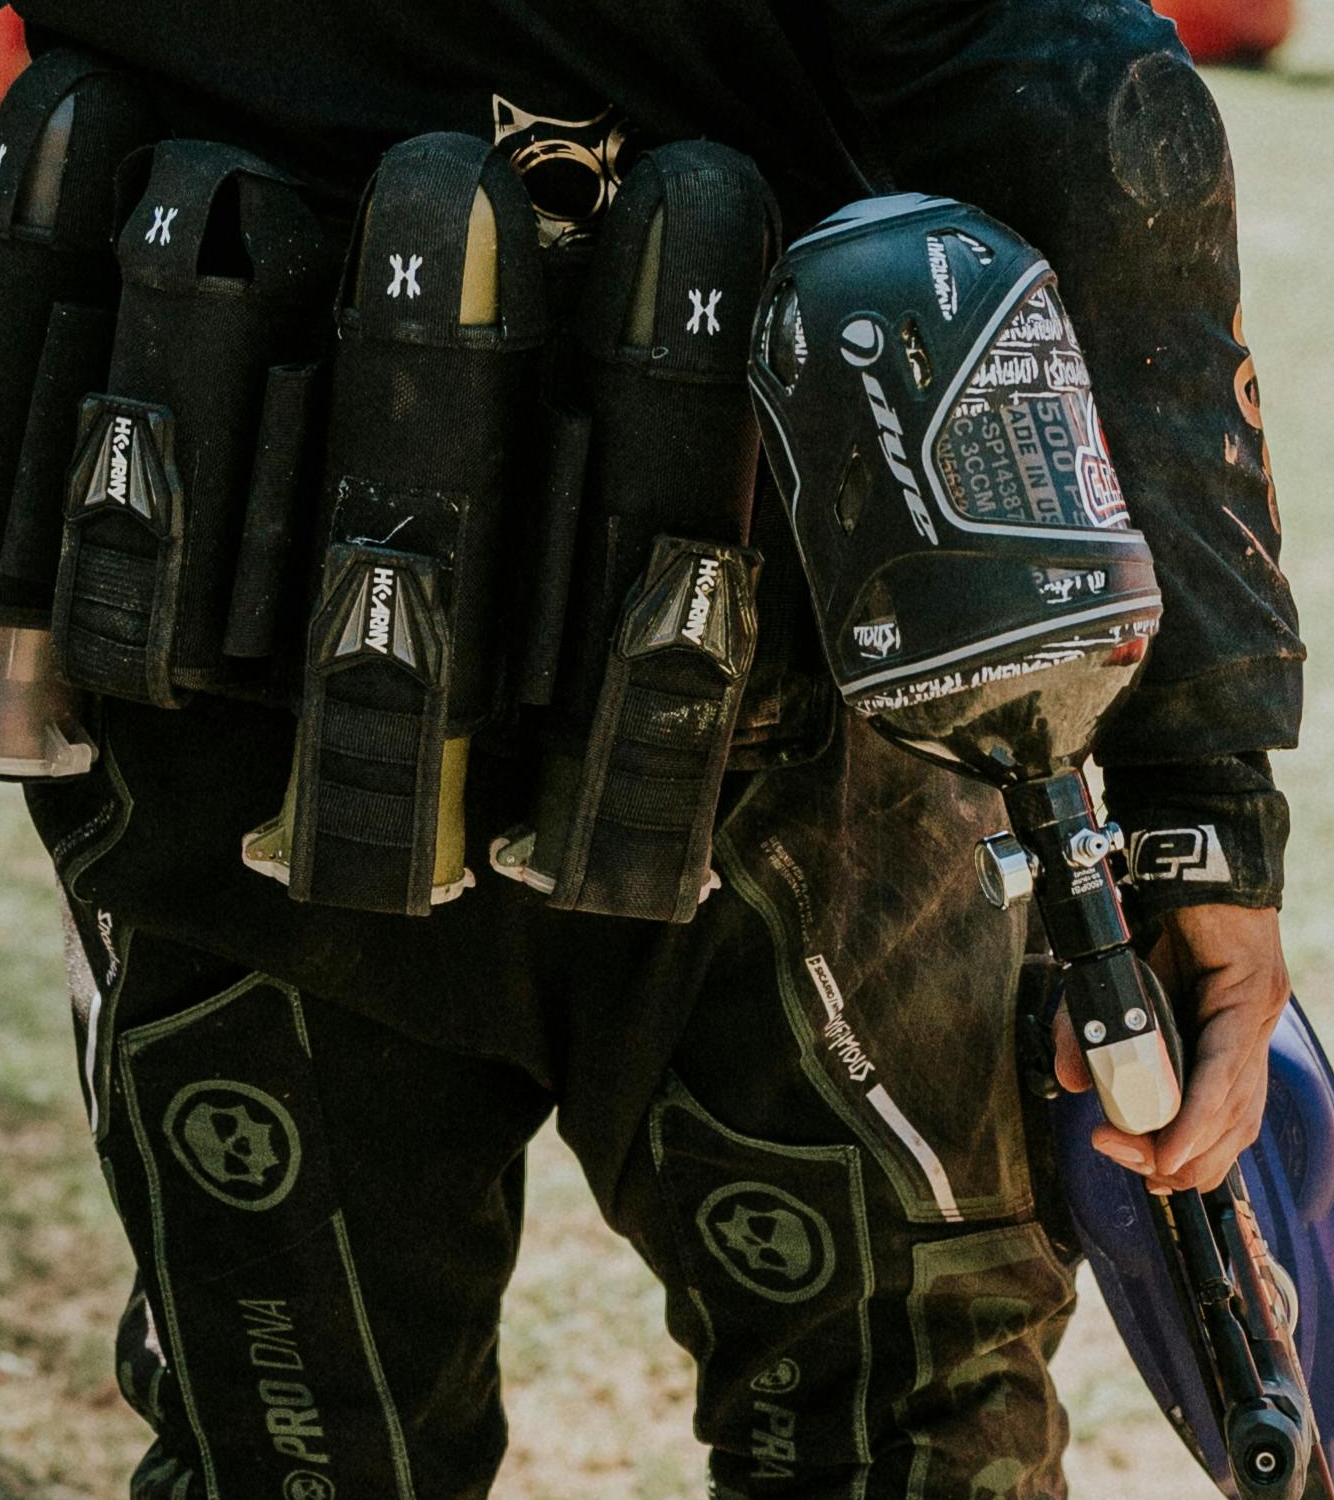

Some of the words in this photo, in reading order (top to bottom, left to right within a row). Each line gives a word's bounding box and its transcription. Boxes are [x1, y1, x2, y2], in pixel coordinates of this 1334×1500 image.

[1008, 406, 1034, 459] ADE
[1024, 462, 1046, 491] IN
[1037, 398, 1075, 477] 500
[823, 1011, 876, 1083] INFAMOUS
[236, 1298, 305, 1371] DNA
[258, 1379, 331, 1465] PRO
